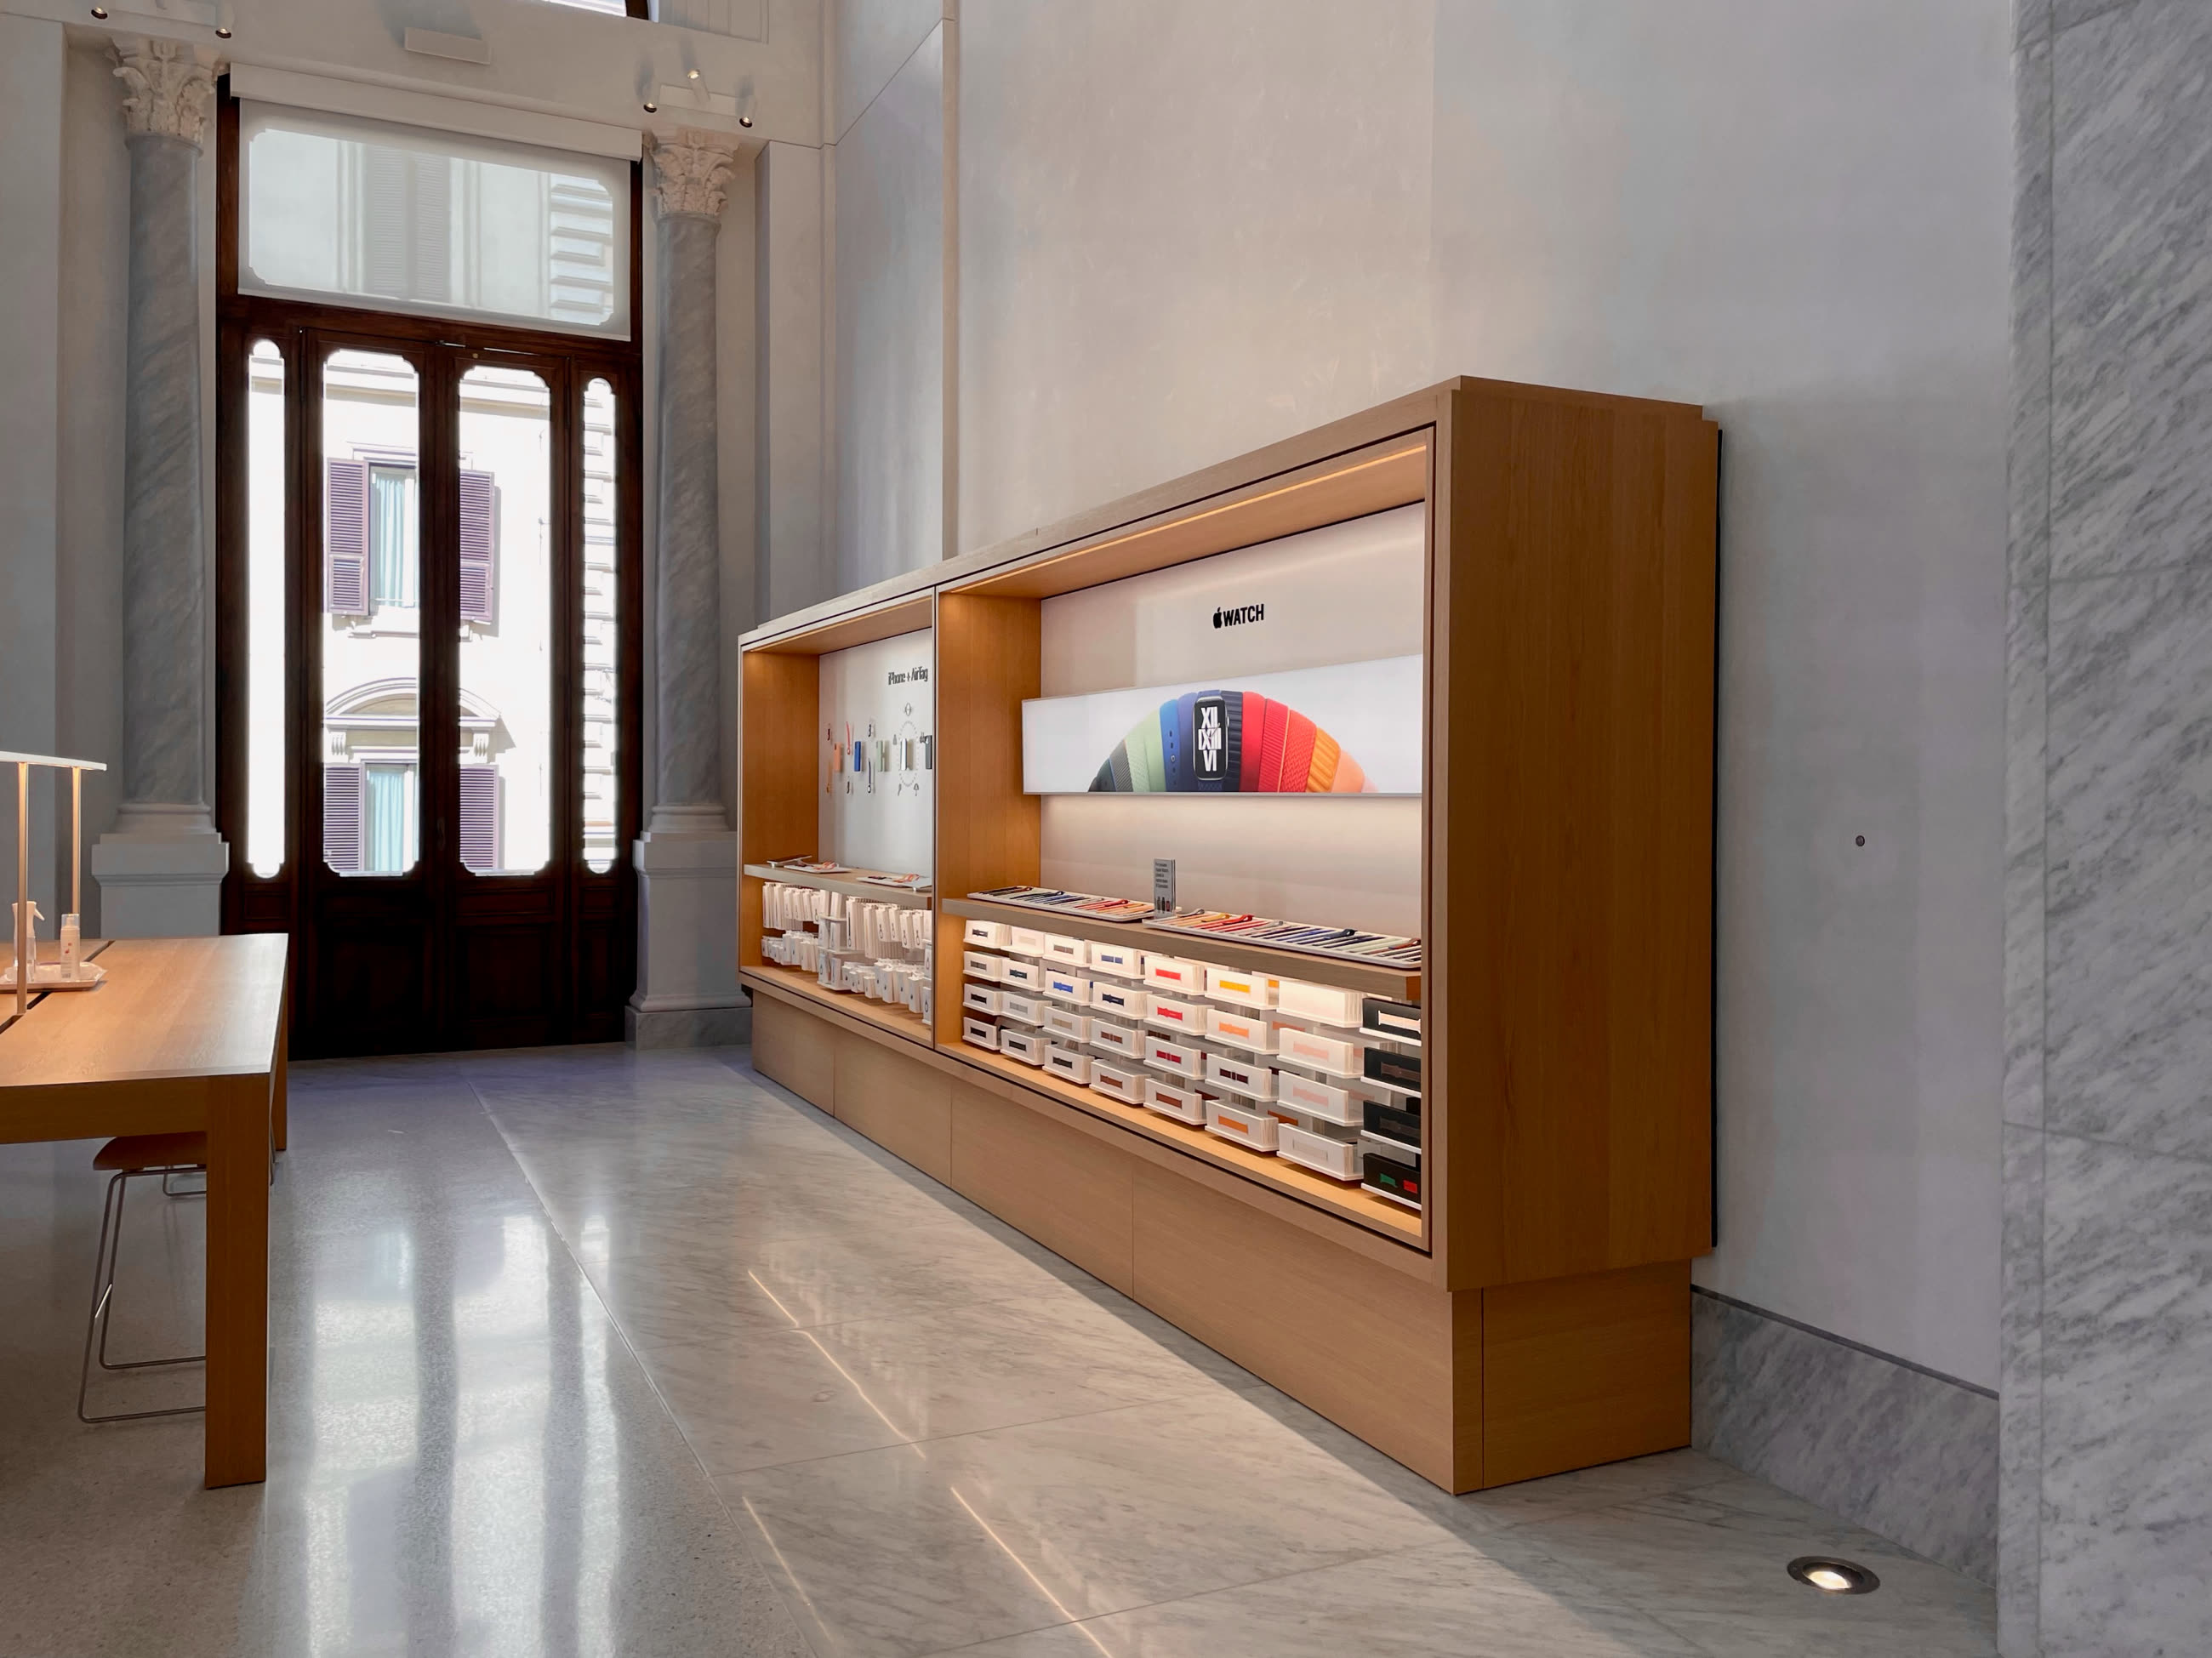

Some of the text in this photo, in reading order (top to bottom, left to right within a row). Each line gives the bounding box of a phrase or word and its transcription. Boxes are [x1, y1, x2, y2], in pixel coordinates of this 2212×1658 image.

[1223, 603, 1264, 627] WATCH
[1200, 706, 1218, 729] XII
[1203, 749, 1217, 772] VI
